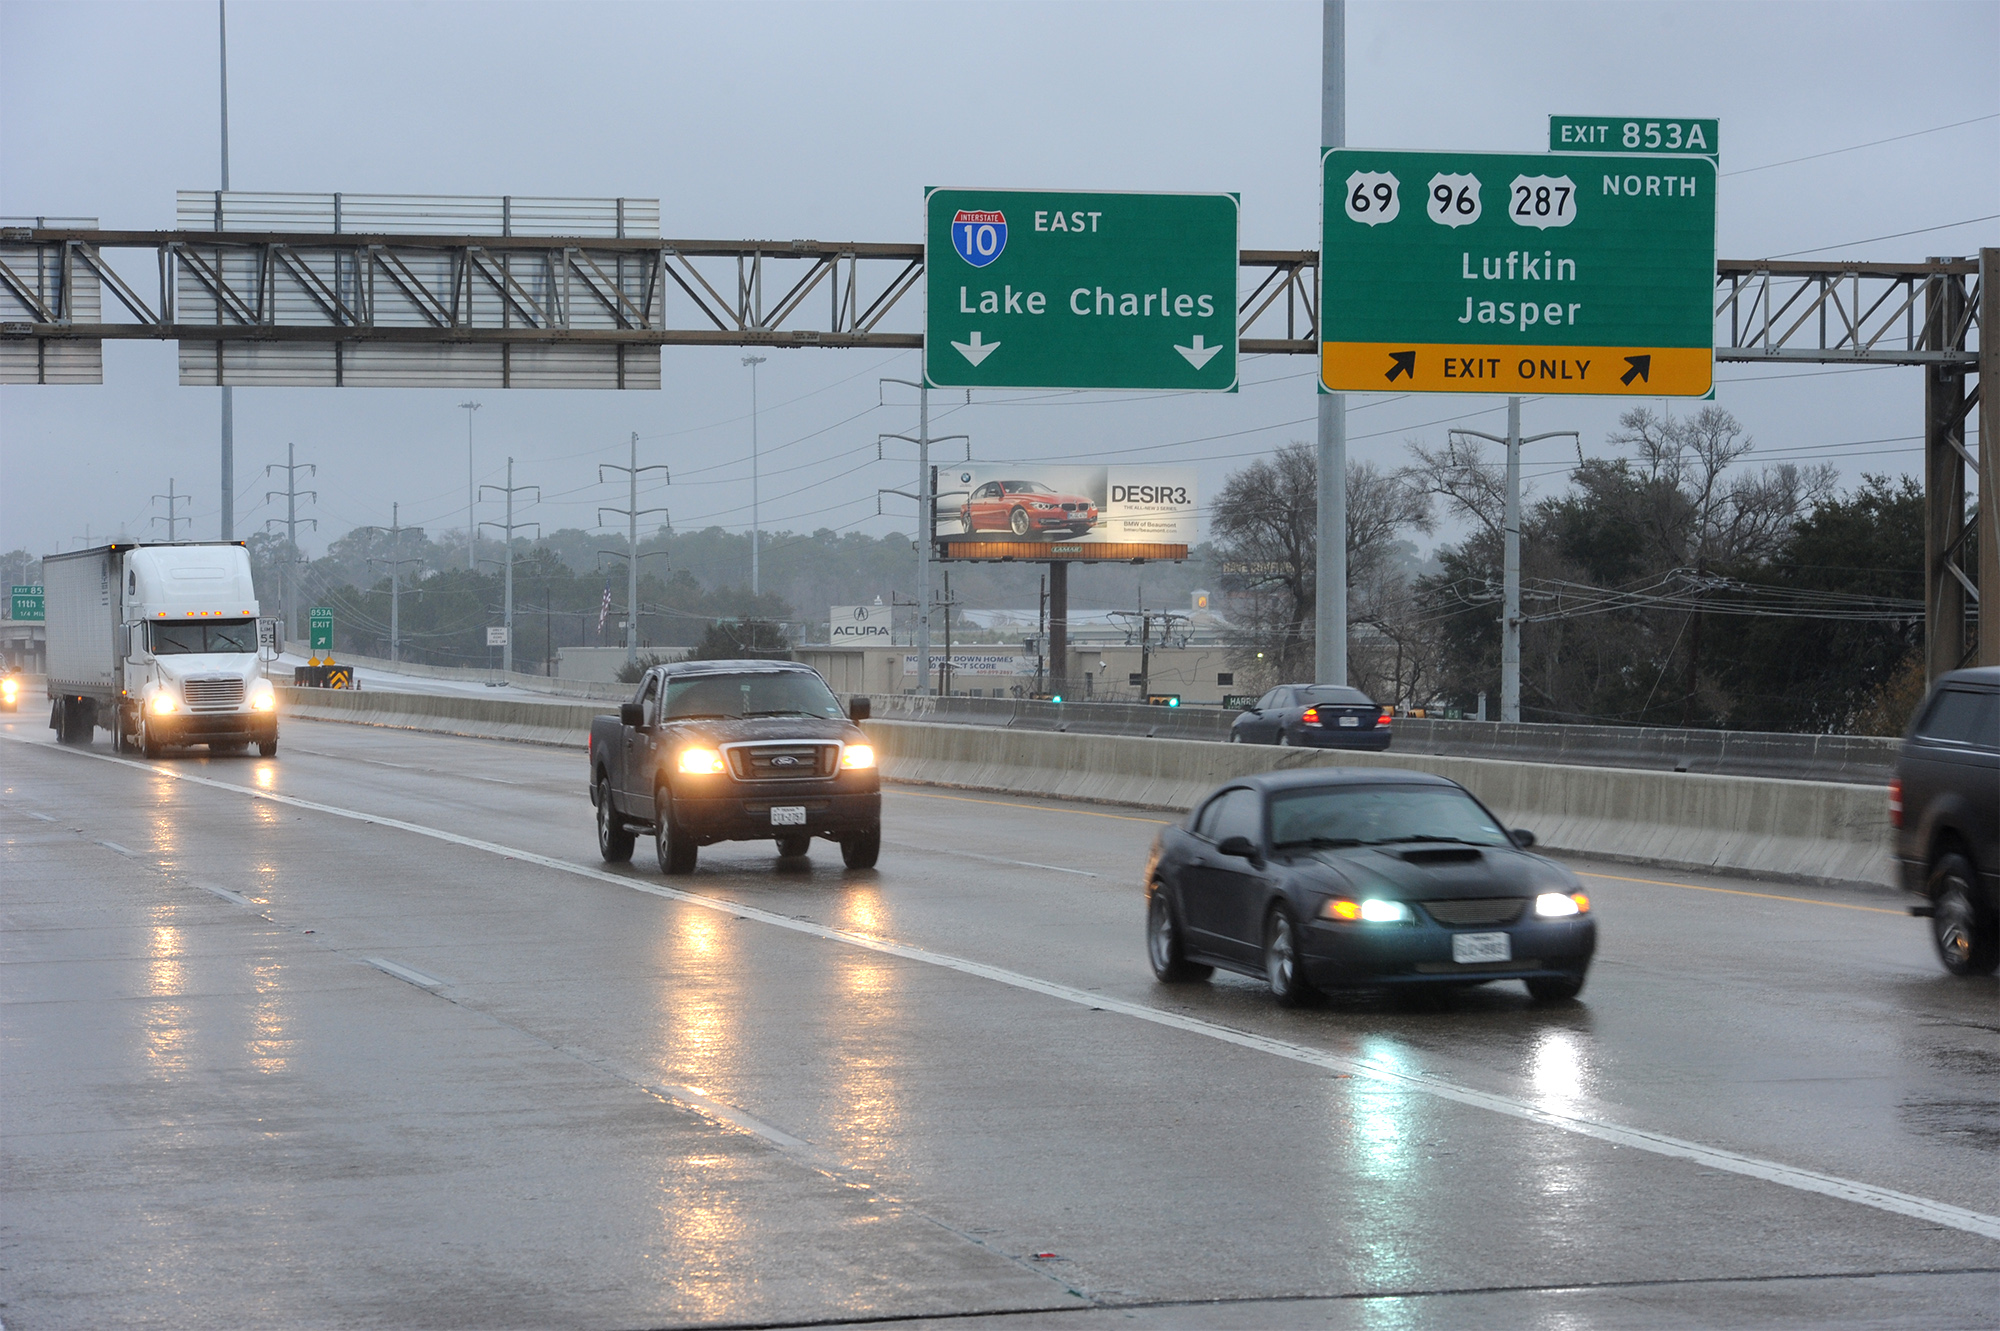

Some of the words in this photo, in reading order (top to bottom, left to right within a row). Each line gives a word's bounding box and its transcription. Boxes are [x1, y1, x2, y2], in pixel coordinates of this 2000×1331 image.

[1561, 125, 1609, 143] EXIT
[1622, 123, 1707, 149] 853A
[1351, 182, 1393, 213] 69
[1603, 175, 1696, 197] NORTH
[1433, 184, 1476, 214] 96
[1515, 186, 1571, 217] 287
[960, 213, 999, 222] INTERSTATE
[1034, 211, 1102, 233] EAST
[964, 224, 998, 256] 10
[1462, 251, 1576, 281] Lufkin
[960, 285, 1046, 314] Lake
[1069, 286, 1214, 317] Charles
[1458, 297, 1581, 332] Jasper
[1443, 357, 1501, 379] EXIT
[1517, 359, 1591, 380] ONLY
[1111, 485, 1191, 505] DESIR3.
[30, 586, 45, 595] 85
[17, 600, 37, 608] 11th
[260, 634, 275, 643] 55
[833, 626, 889, 636] ACURA
